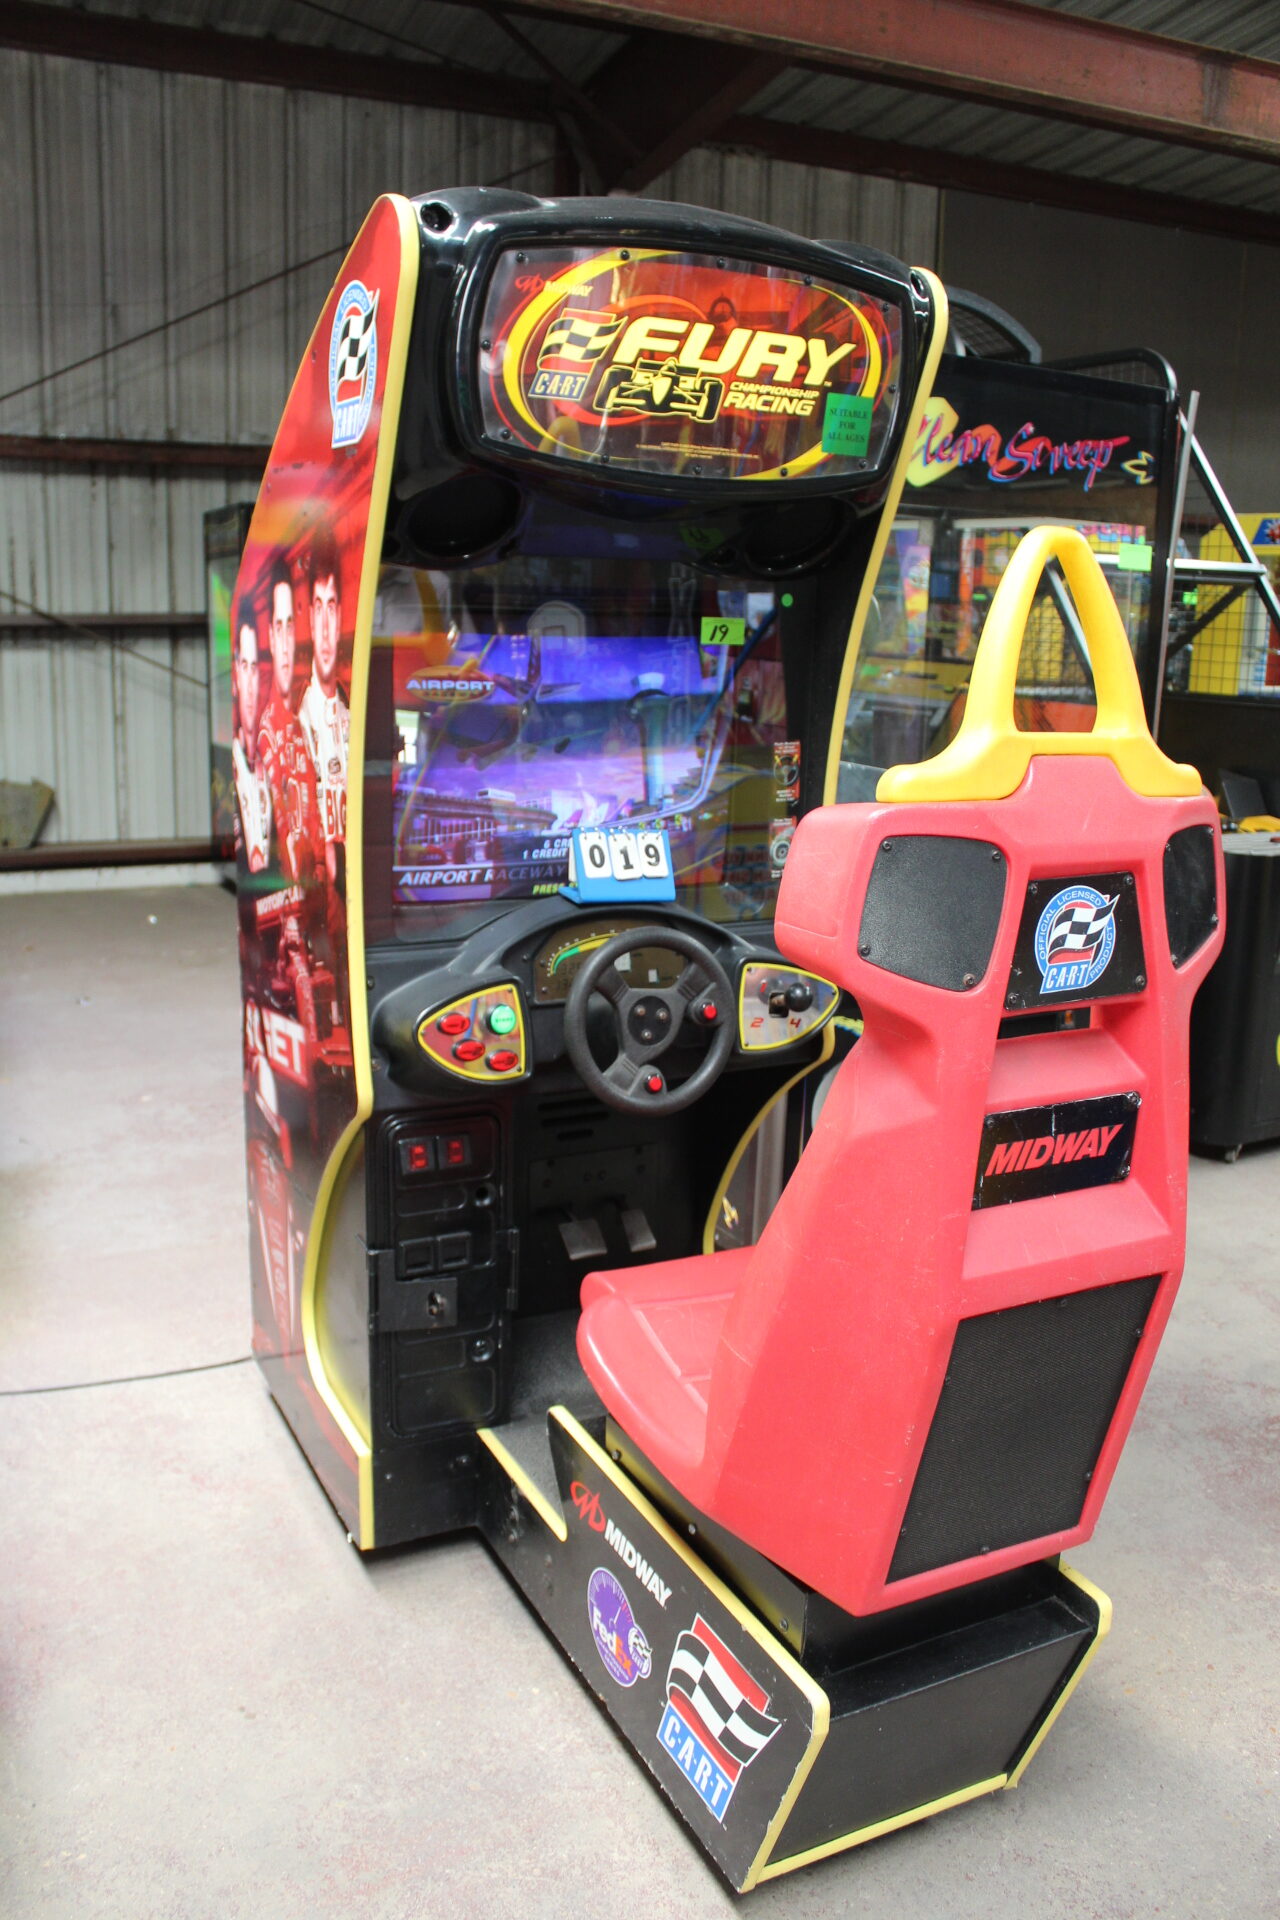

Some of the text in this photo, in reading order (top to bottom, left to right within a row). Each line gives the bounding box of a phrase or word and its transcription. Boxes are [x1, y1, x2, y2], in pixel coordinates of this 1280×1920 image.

[613, 315, 857, 386] FURY
[729, 381, 820, 399] CHAMPIONSHIP
[723, 391, 816, 417] RACING
[830, 407, 868, 419] SUITABLE
[839, 421, 856, 431] FOR
[987, 421, 1116, 492] Sweep
[709, 624, 729, 642] 19
[406, 679, 494, 691] AIRPORT
[532, 847, 568, 860] CREDIT
[399, 864, 567, 886] AIRPORT RACEWAY
[1038, 890, 1113, 979] OFFICIAL LICENSED PRODUCT
[750, 1017, 802, 1028] 2 4
[984, 1123, 1124, 1177] MIDWAY
[604, 1518, 673, 1608] MIDWAY
[593, 1606, 633, 1679] FedEx
